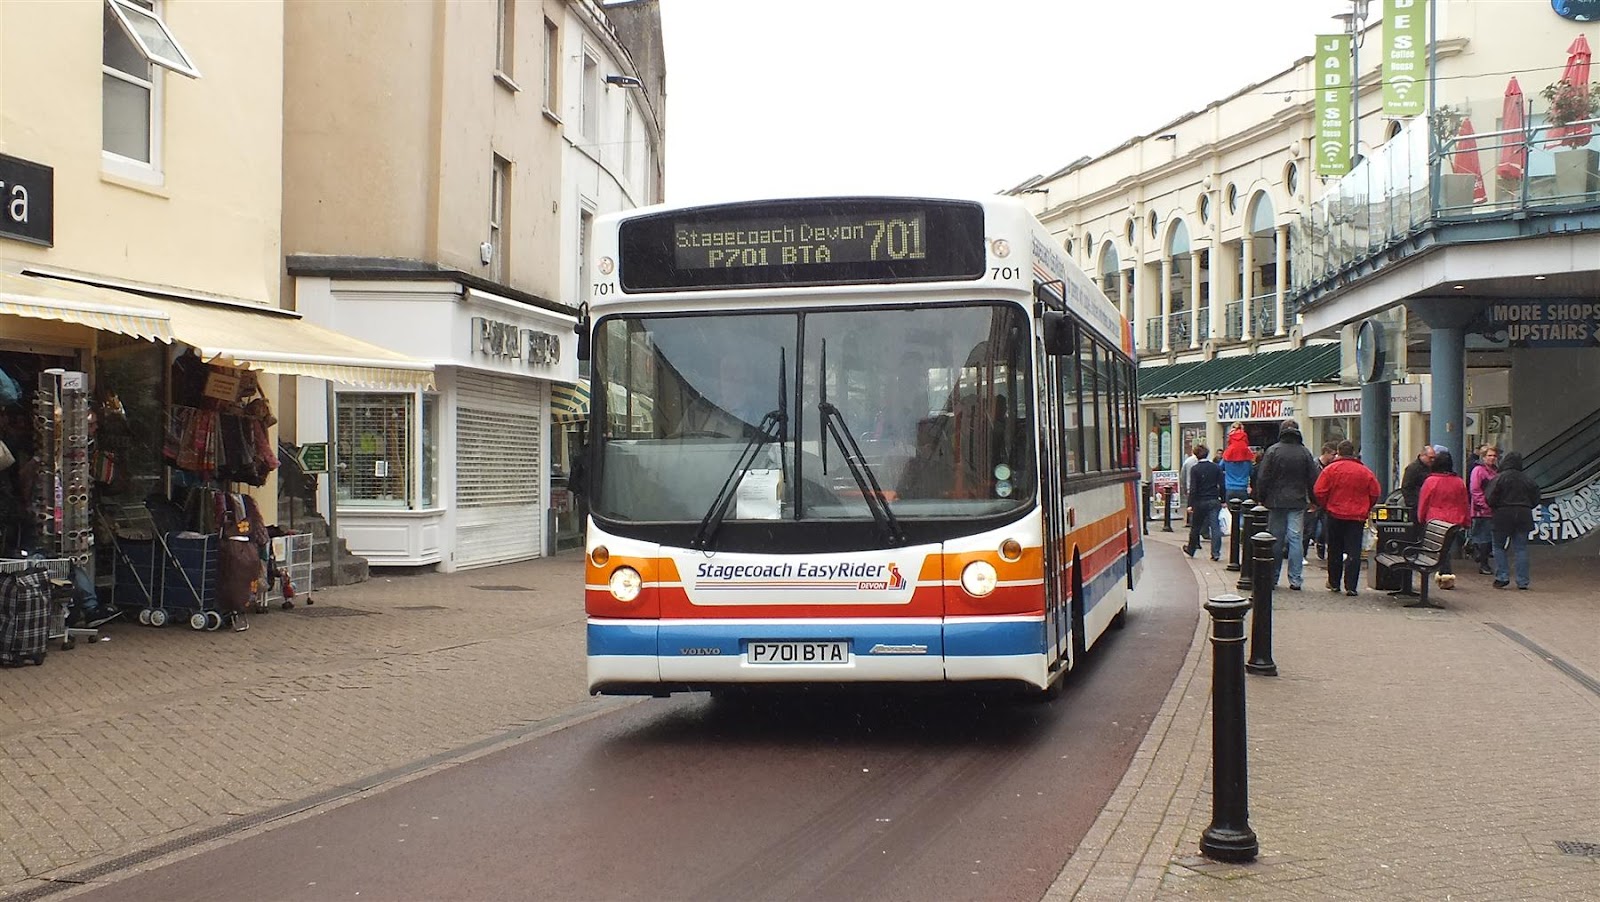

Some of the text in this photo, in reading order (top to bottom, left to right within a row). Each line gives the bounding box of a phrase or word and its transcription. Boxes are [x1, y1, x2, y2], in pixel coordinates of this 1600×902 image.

[1394, 0, 1413, 49] DES
[1323, 39, 1340, 119] JADES
[676, 224, 864, 248] Stagecoach Devon
[865, 218, 926, 261] 701
[709, 245, 831, 268] P701 BTA
[991, 266, 1020, 280] 701
[593, 282, 614, 296] 701
[1494, 304, 1600, 321] MORE SHOPS
[1508, 324, 1588, 340] UPSTAIRS
[1218, 400, 1250, 419] SPORTS
[1334, 394, 1361, 413] bonmar
[1528, 506, 1600, 540] PSTAIRS
[697, 563, 885, 580] Stagecoach EasyRider
[754, 644, 842, 661] P701 BTA
